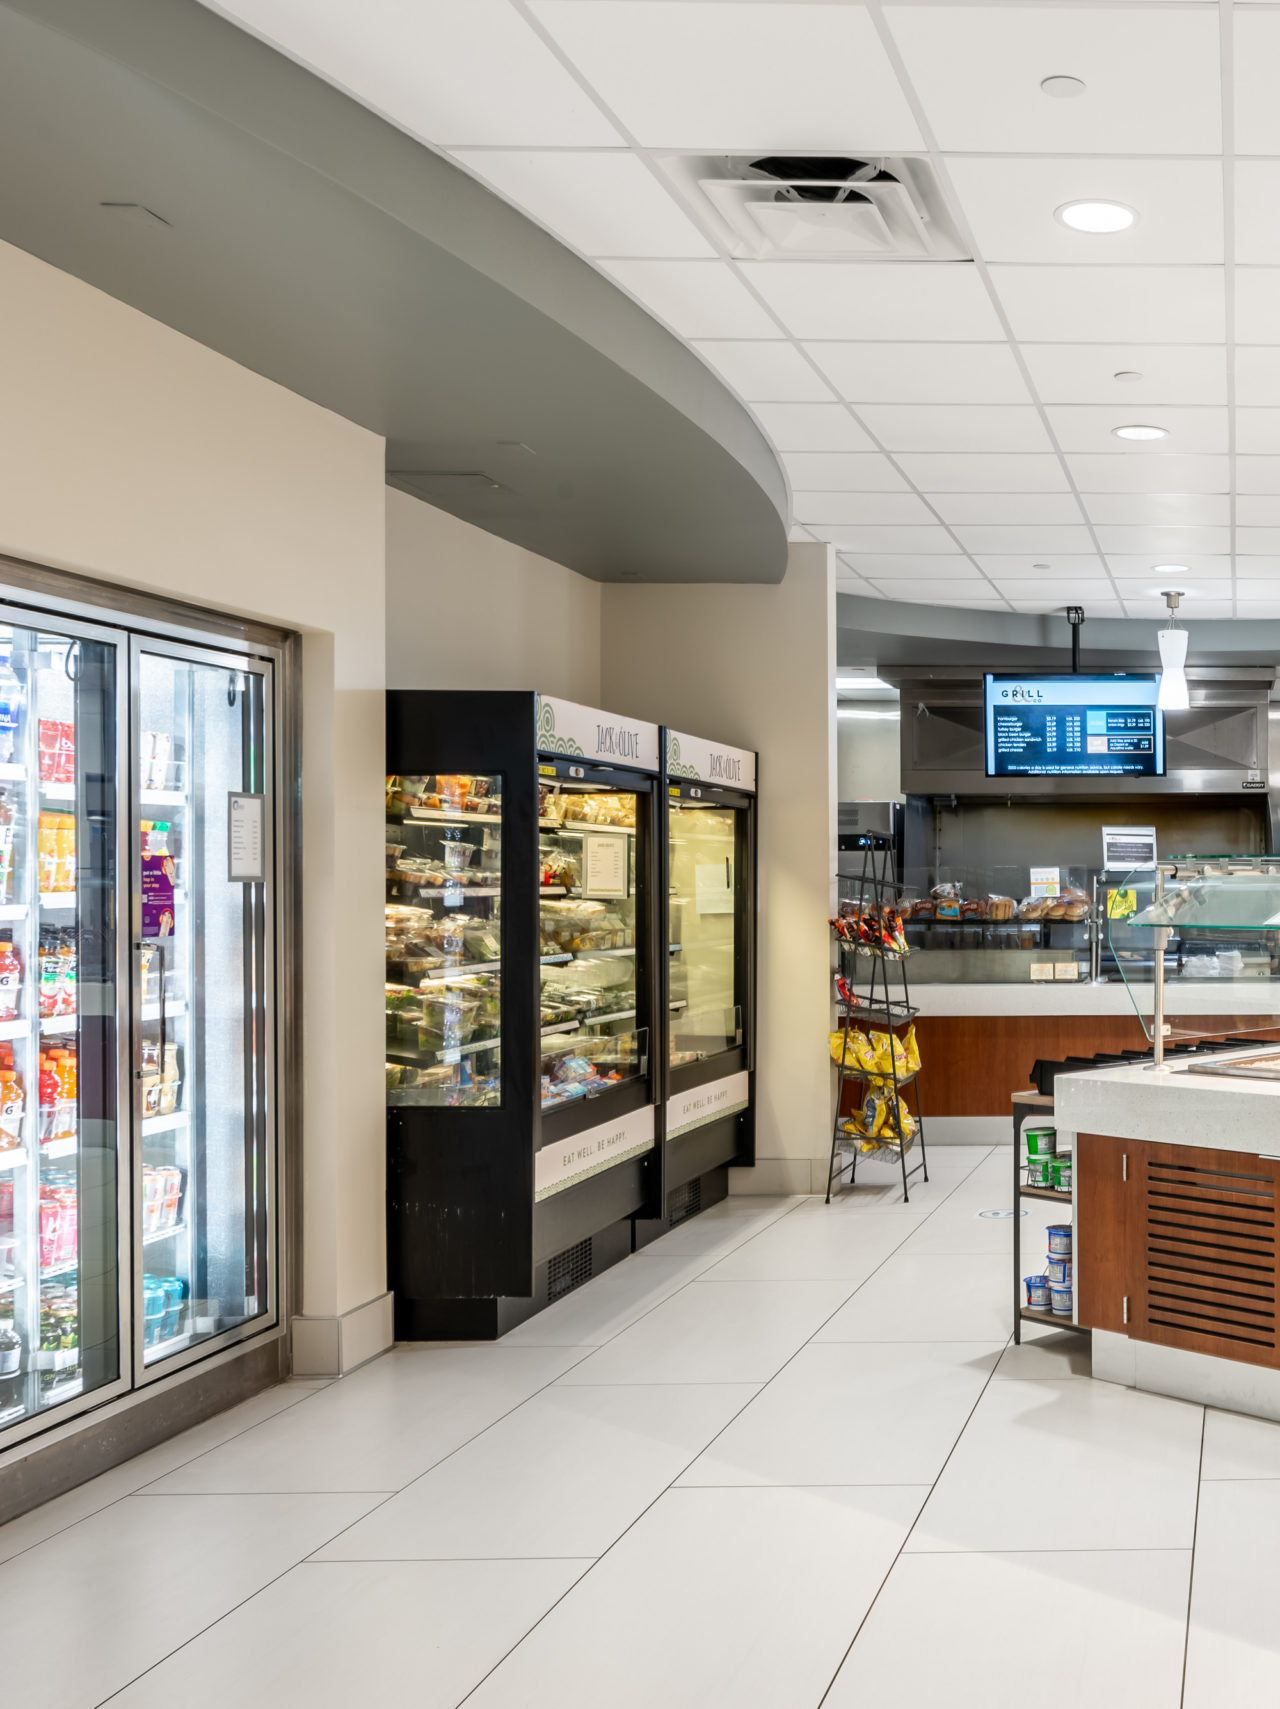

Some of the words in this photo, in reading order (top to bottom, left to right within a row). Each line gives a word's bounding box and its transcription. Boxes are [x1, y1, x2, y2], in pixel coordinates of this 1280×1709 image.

[1002, 690, 1043, 698] GRILL
[596, 724, 614, 754] JACK
[709, 754, 723, 778] JACK
[0, 976, 9, 985] G
[4, 1105, 13, 1115] G
[683, 1104, 691, 1114] EAT
[707, 1095, 713, 1105] BE
[563, 1152, 574, 1167] EAT
[577, 1145, 595, 1160] WELL.
[597, 1140, 605, 1151] BE
[607, 1131, 627, 1148] HAPPY.
